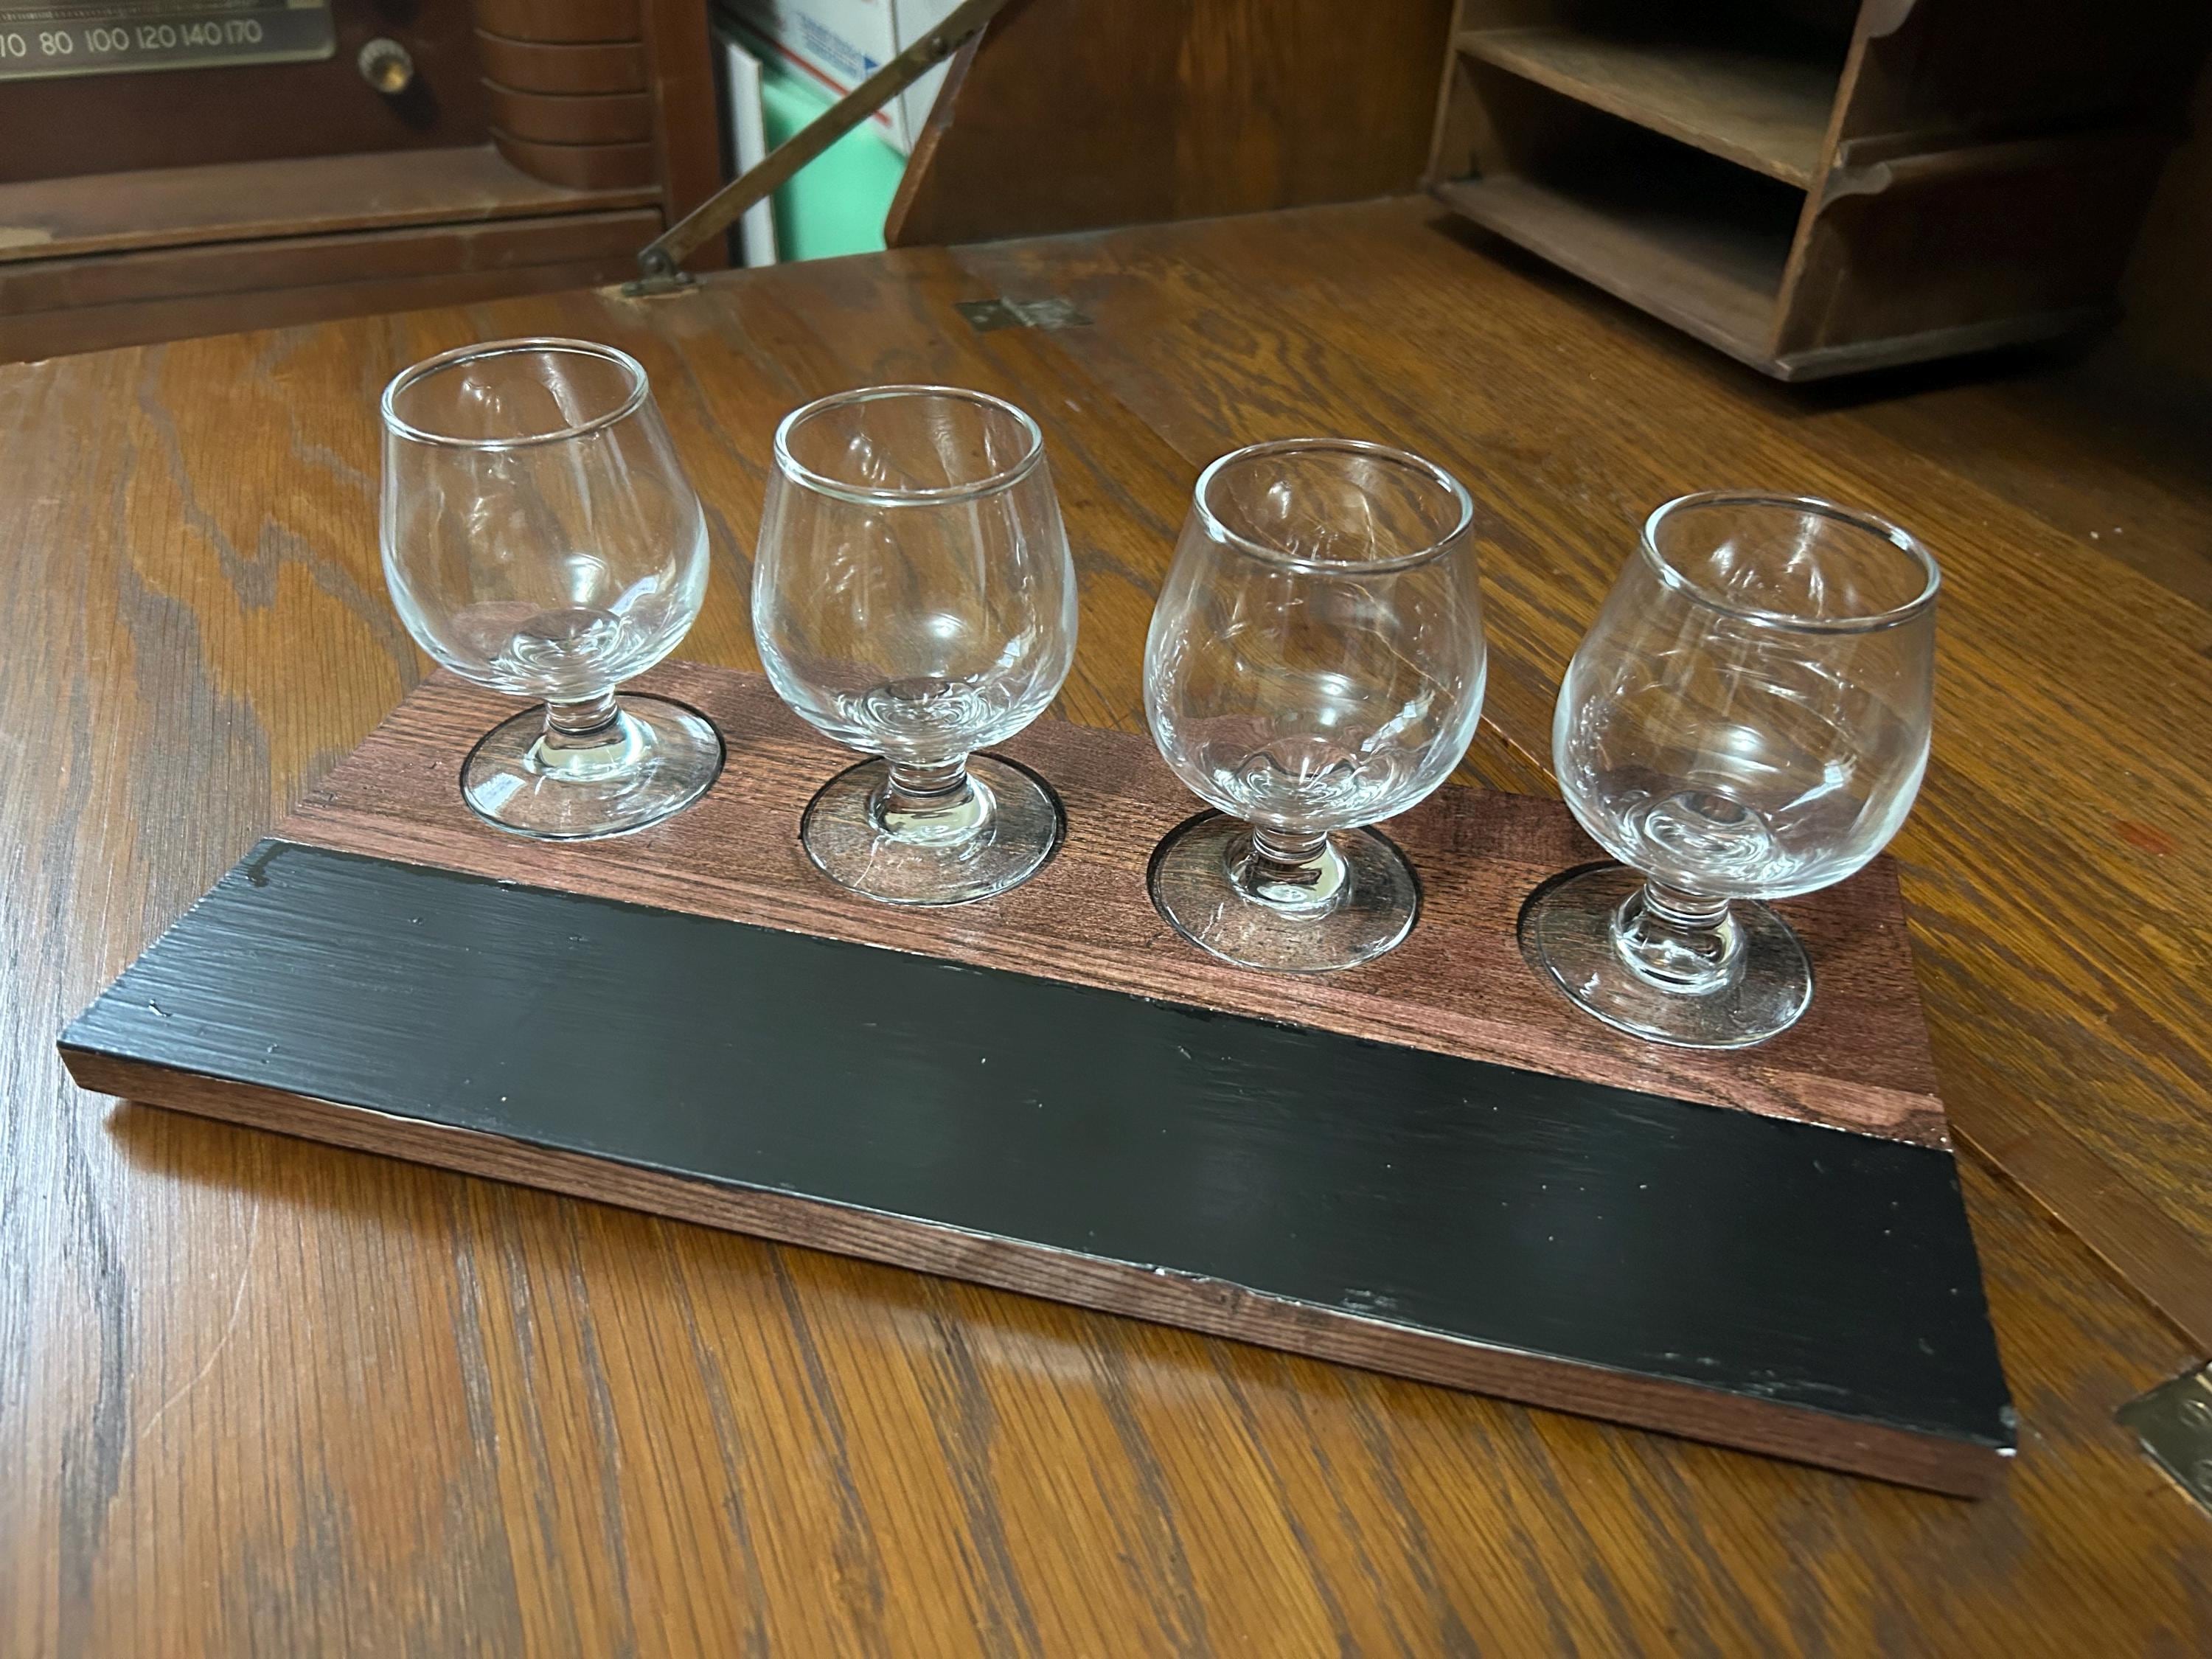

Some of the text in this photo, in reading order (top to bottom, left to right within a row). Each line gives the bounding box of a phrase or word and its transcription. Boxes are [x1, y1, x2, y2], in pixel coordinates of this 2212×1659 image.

[39, 31, 73, 55] 80
[85, 27, 130, 52] 100
[136, 24, 176, 49] 120
[181, 21, 221, 46] 140
[224, 18, 262, 44] 170
